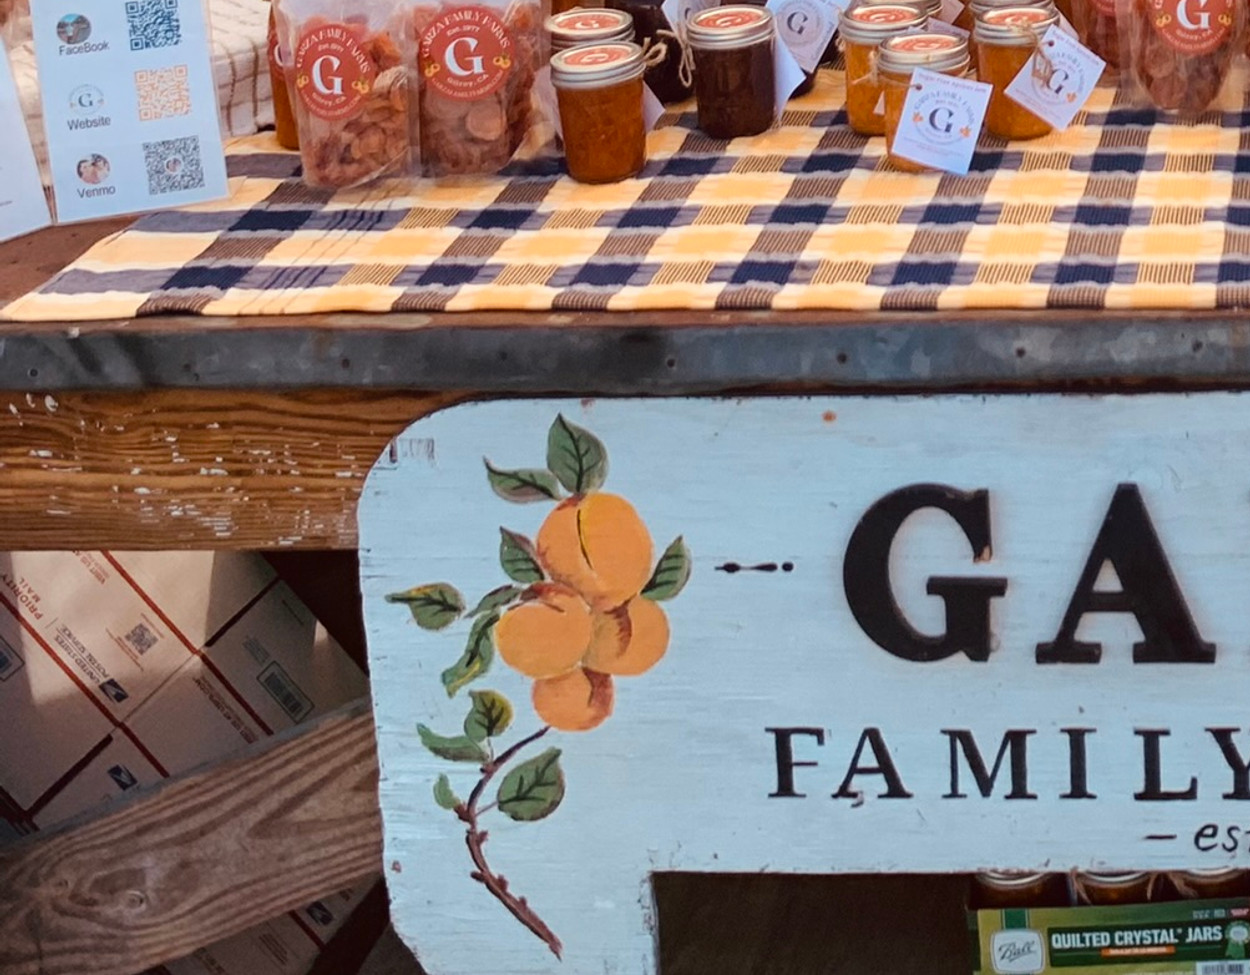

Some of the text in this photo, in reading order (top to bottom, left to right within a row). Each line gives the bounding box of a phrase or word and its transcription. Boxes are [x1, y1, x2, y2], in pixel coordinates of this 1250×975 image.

[787, 11, 808, 34] G
[58, 40, 109, 56] FaceBook
[445, 37, 485, 76] G
[312, 54, 343, 95] G
[67, 116, 111, 131] Website
[929, 107, 953, 133] G
[77, 185, 116, 198] Venmo
[0, 572, 44, 620] PRIORITY
[16, 576, 42, 603] MAIL
[53, 634, 101, 685] UNITED STATES
[85, 652, 111, 679] POSTAL
[1051, 931, 1110, 949] QUILTED
[1184, 926, 1223, 943] JARS
[998, 941, 1036, 962] Ball
